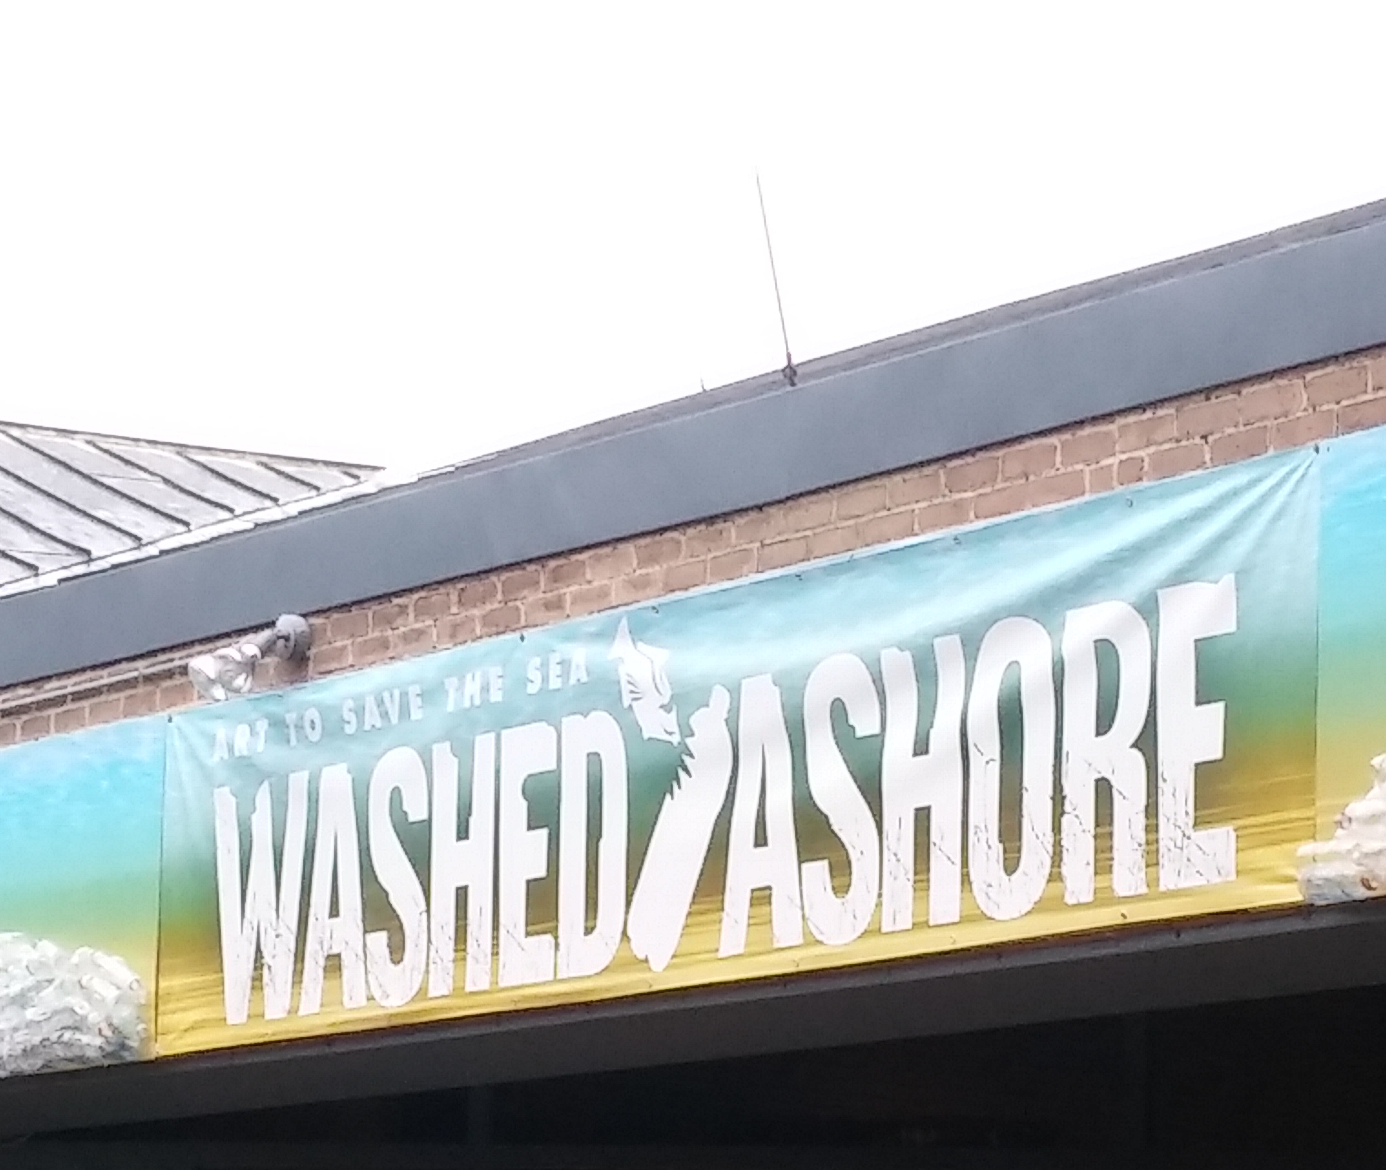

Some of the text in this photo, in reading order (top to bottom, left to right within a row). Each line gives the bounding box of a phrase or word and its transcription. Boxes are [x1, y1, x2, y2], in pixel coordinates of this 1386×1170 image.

[213, 648, 588, 761] ART TO SAVE THE SEA
[214, 576, 1237, 1026] WASHED ASHORE
